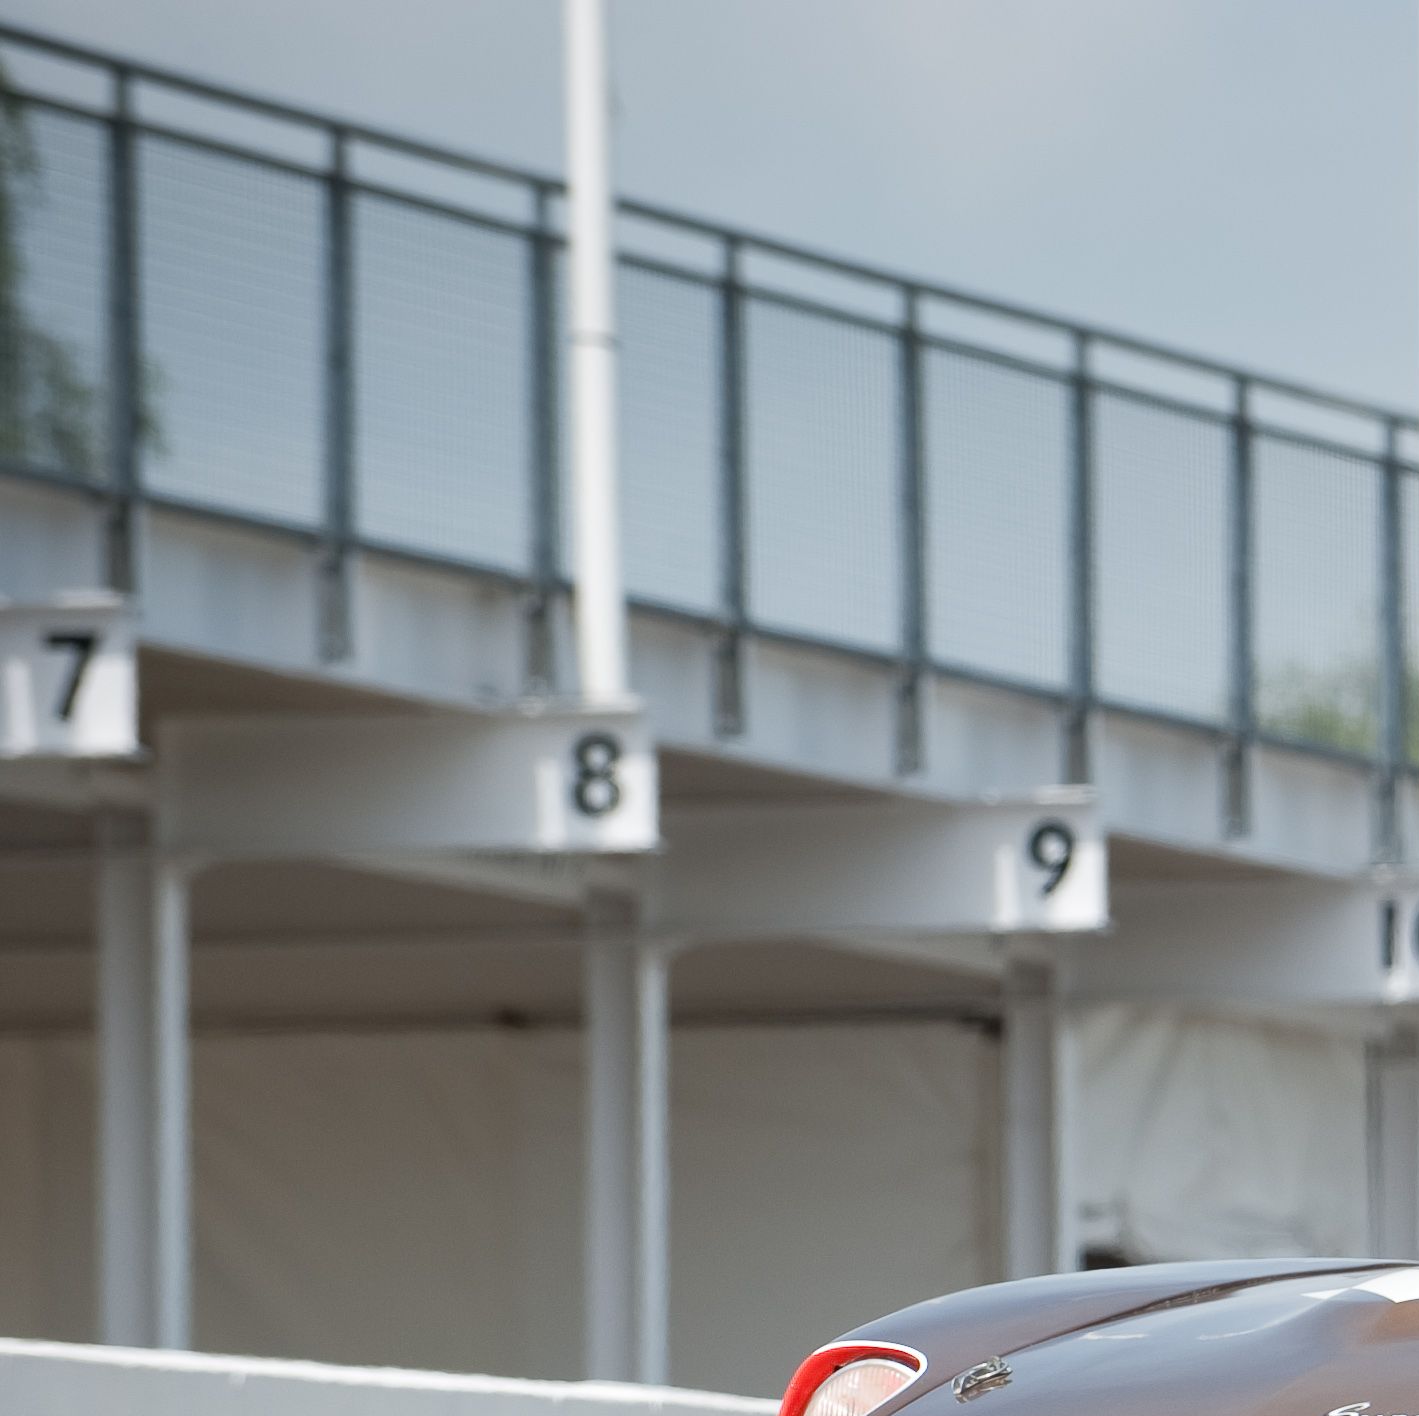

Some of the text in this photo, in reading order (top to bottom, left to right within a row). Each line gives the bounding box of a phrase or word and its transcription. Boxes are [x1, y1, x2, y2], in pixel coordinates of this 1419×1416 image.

[45, 632, 96, 720] 7
[573, 731, 621, 817] 8
[1026, 817, 1076, 895] 9
